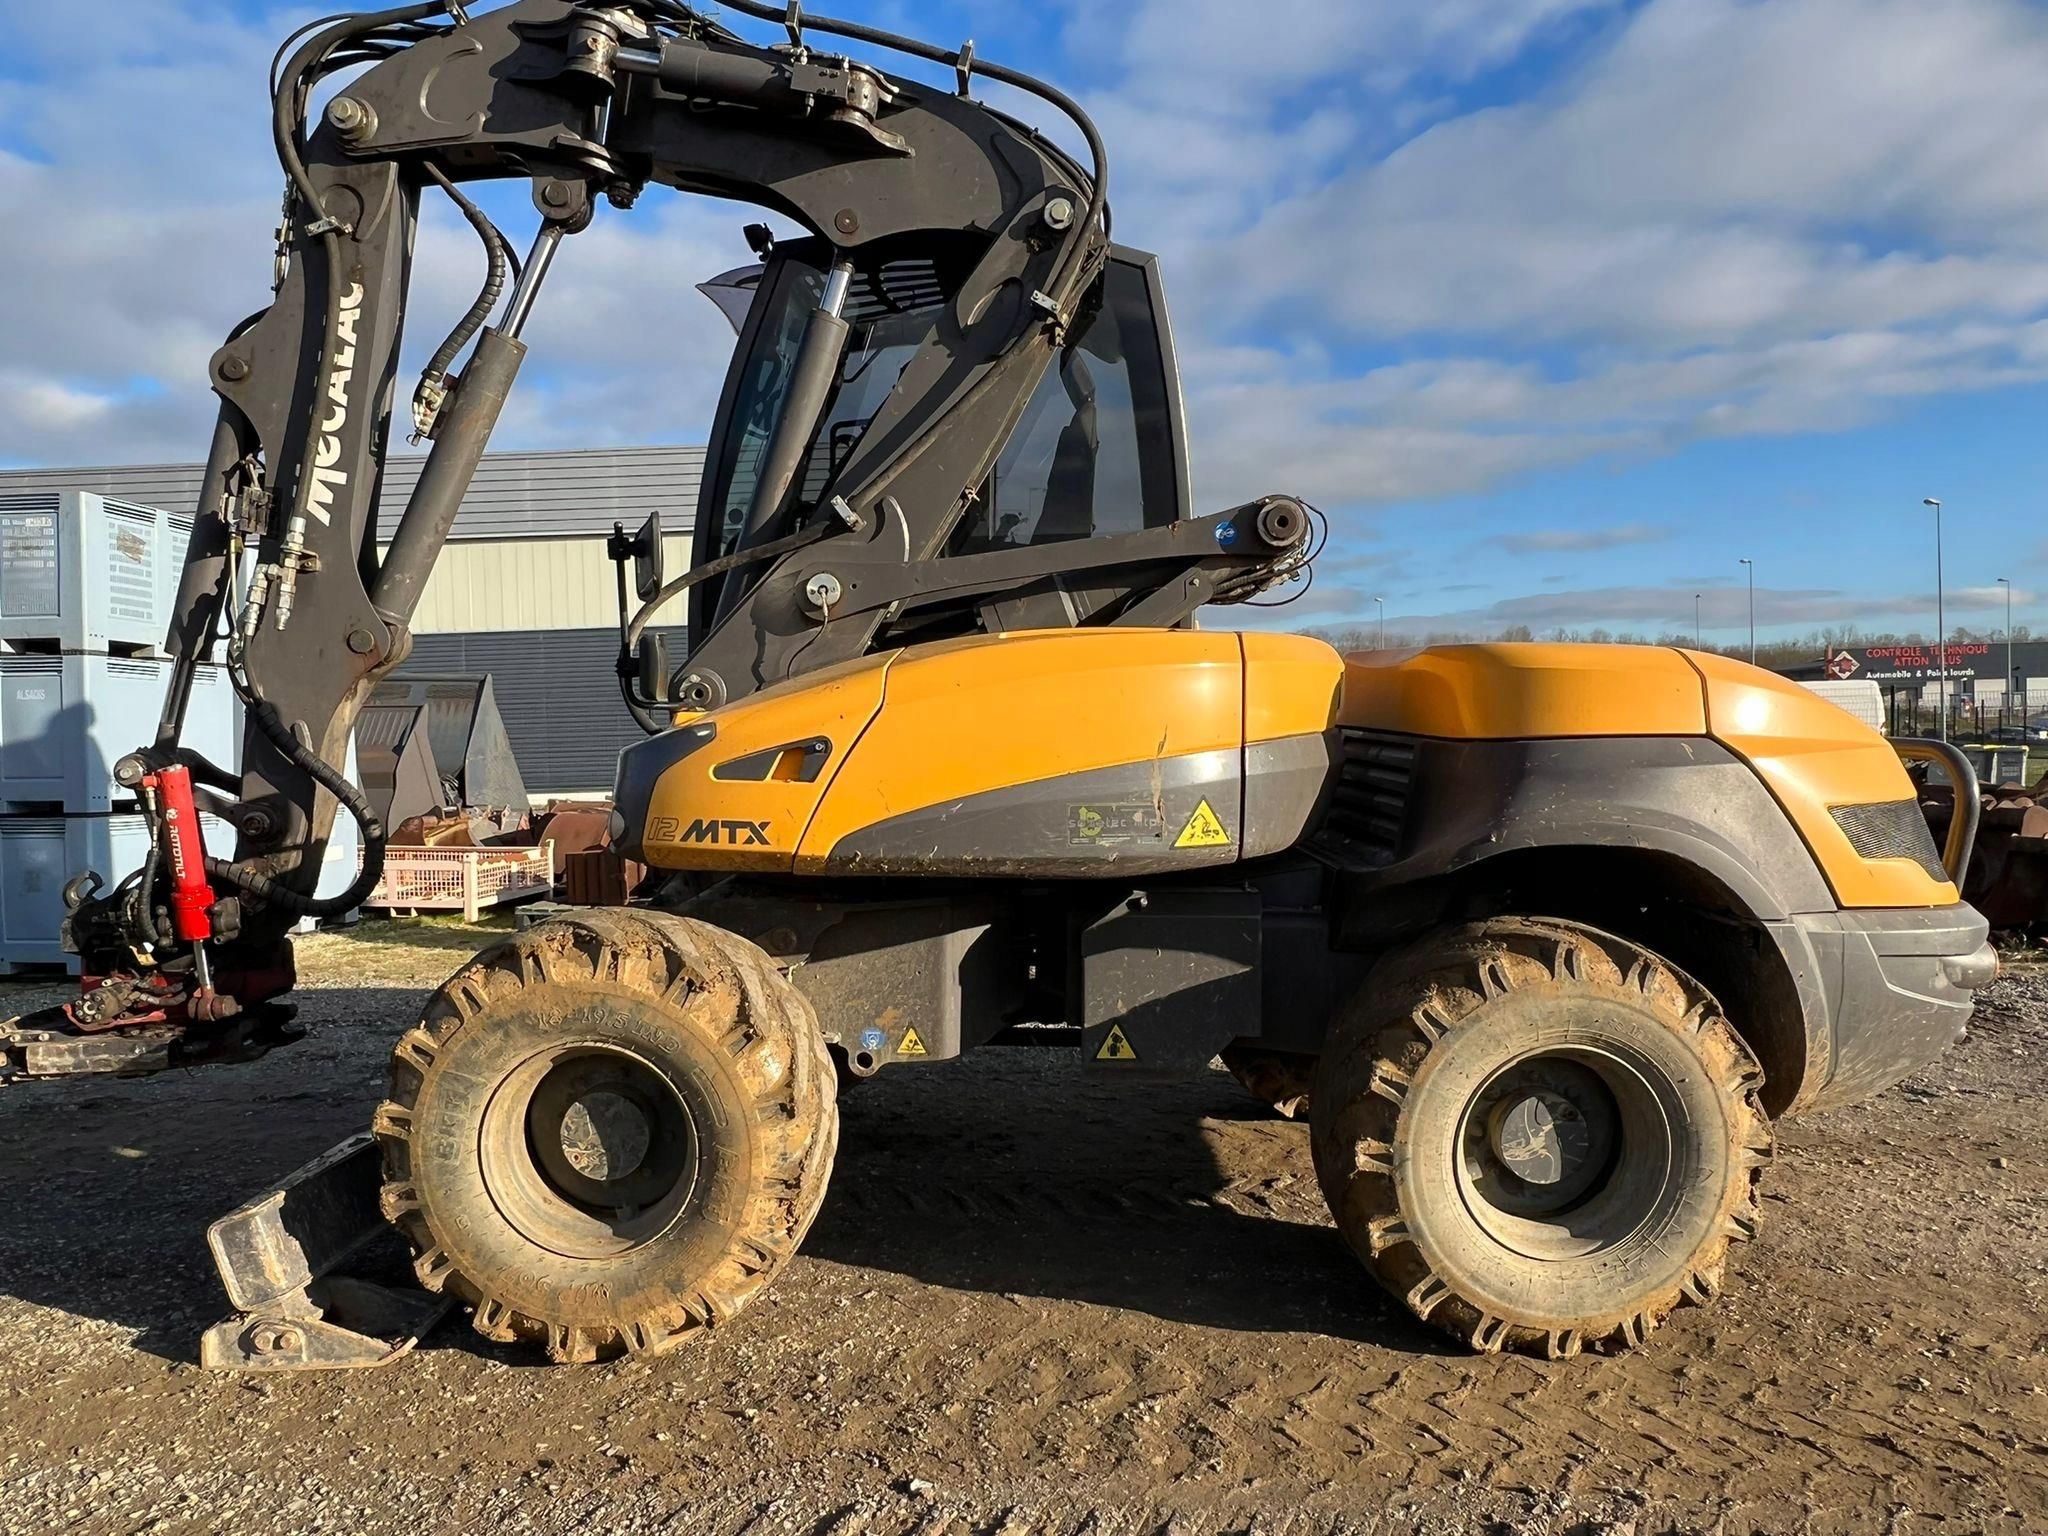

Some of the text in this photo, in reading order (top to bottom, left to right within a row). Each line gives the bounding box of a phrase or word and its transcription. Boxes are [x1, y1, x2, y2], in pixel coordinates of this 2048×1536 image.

[1866, 648, 1921, 658] CONTROLE
[1894, 657, 1929, 666] ATTON
[1866, 670, 1911, 678] Automobile
[1950, 668, 1975, 676] lourds
[648, 817, 771, 845] 12 MTX
[169, 825, 186, 879] ROTOTILT
